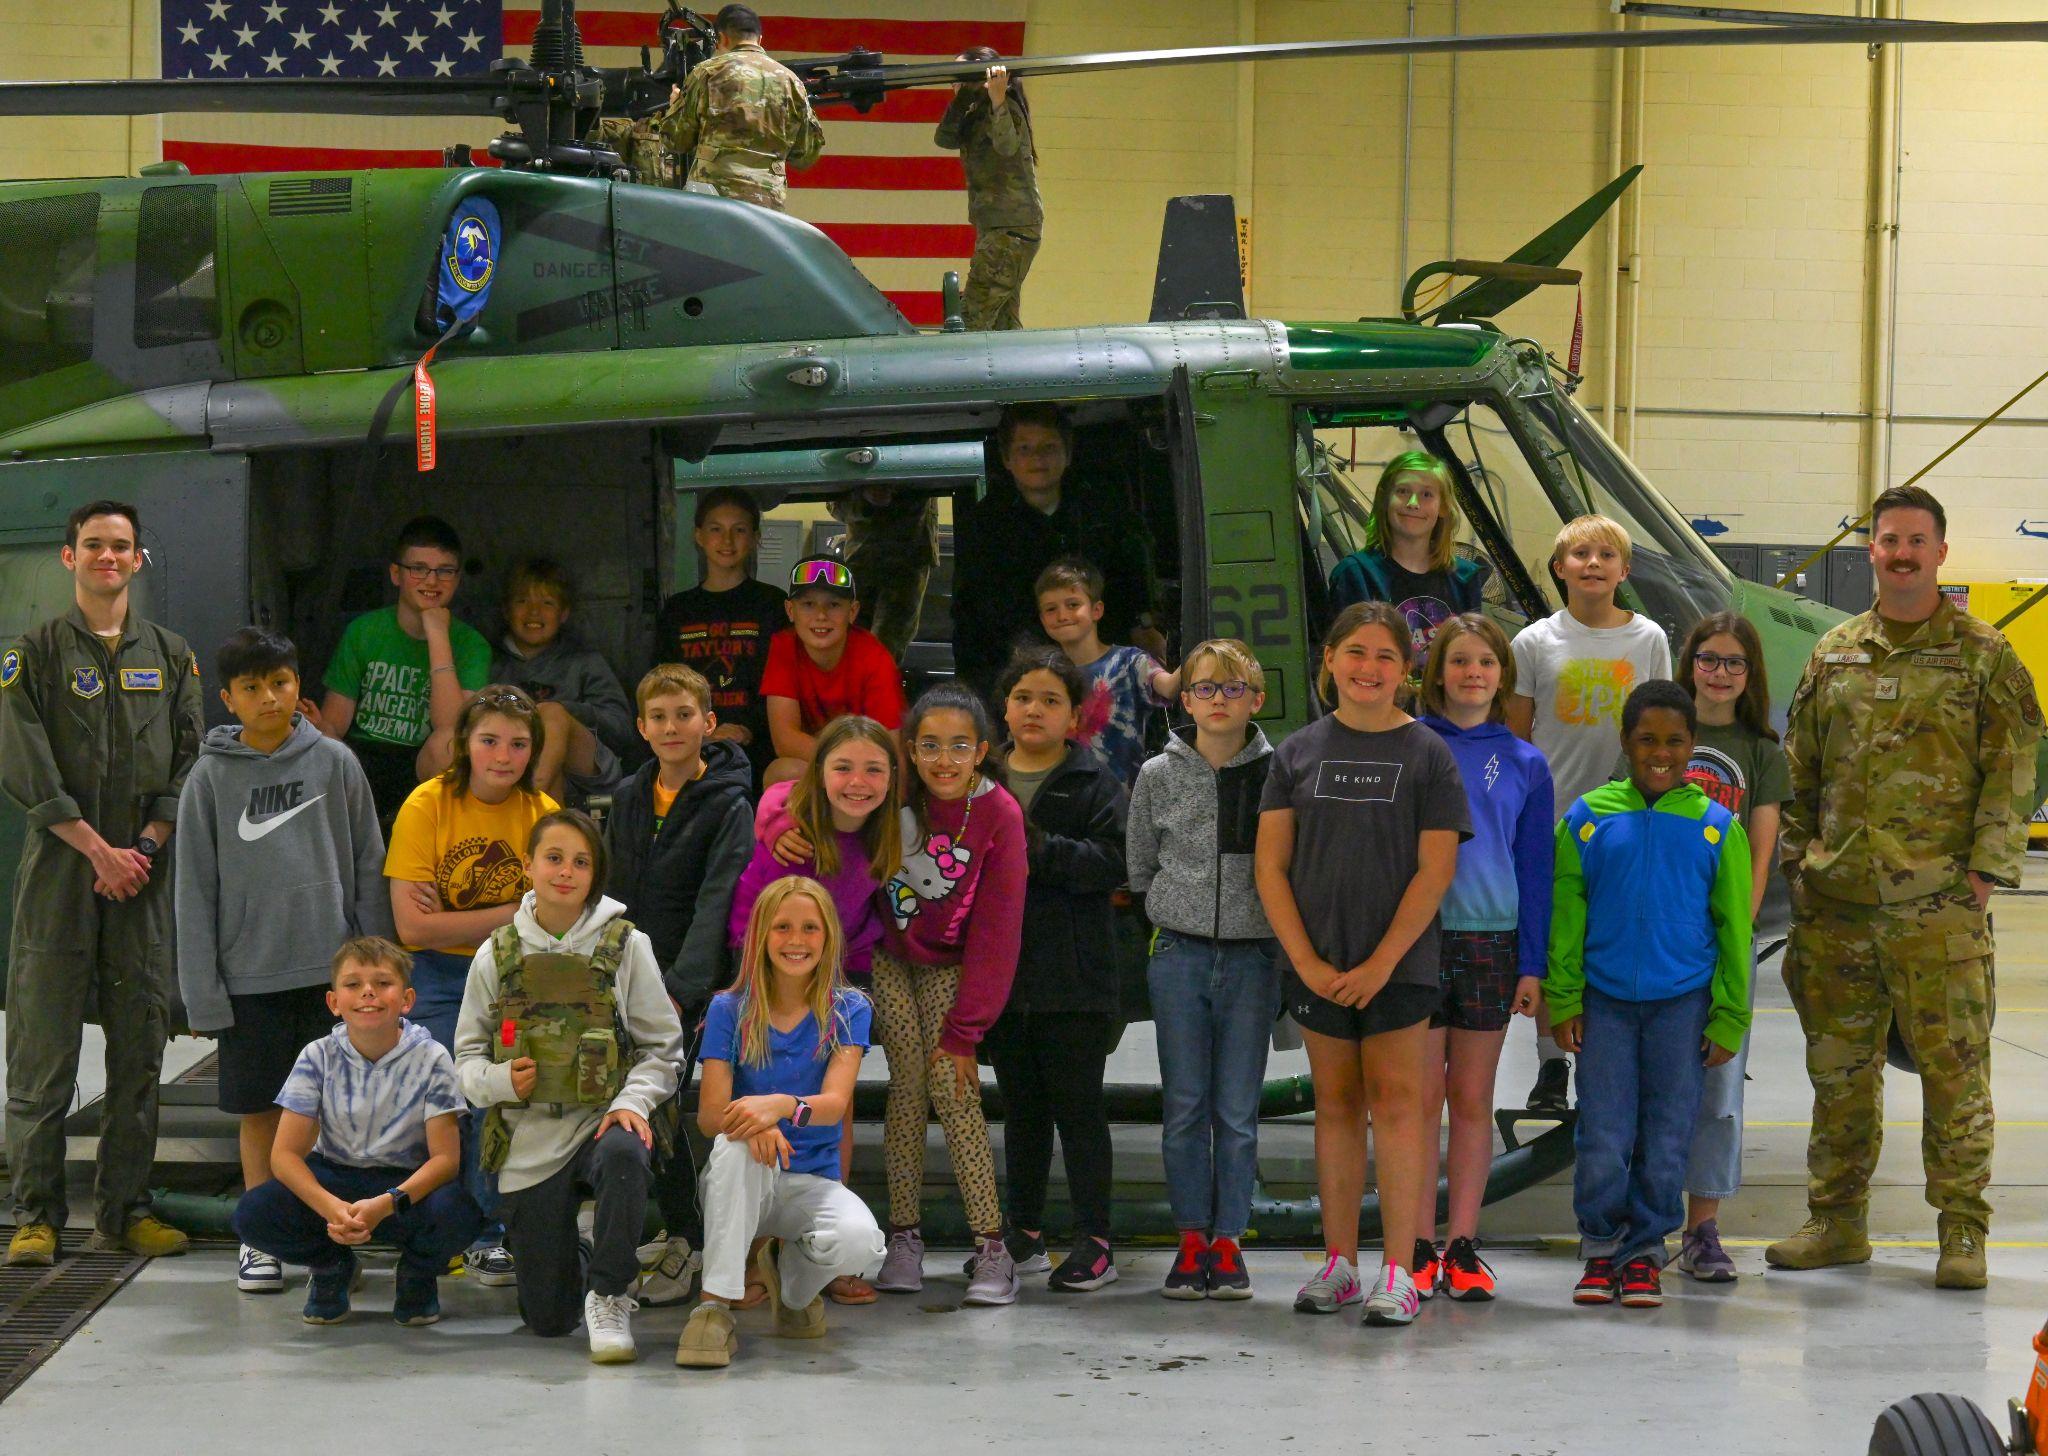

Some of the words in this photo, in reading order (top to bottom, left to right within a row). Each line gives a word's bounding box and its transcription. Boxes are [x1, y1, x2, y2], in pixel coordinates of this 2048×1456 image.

[532, 261, 612, 279] DANGER
[1208, 584, 1291, 647] 62
[1926, 657, 1939, 665] AIR
[1940, 658, 1962, 667] FORCE
[358, 690, 418, 720] ANGER
[356, 711, 419, 742] CADEMY
[1334, 774, 1347, 783] BE
[1354, 776, 1381, 784] KIND
[248, 780, 304, 816] NIKE
